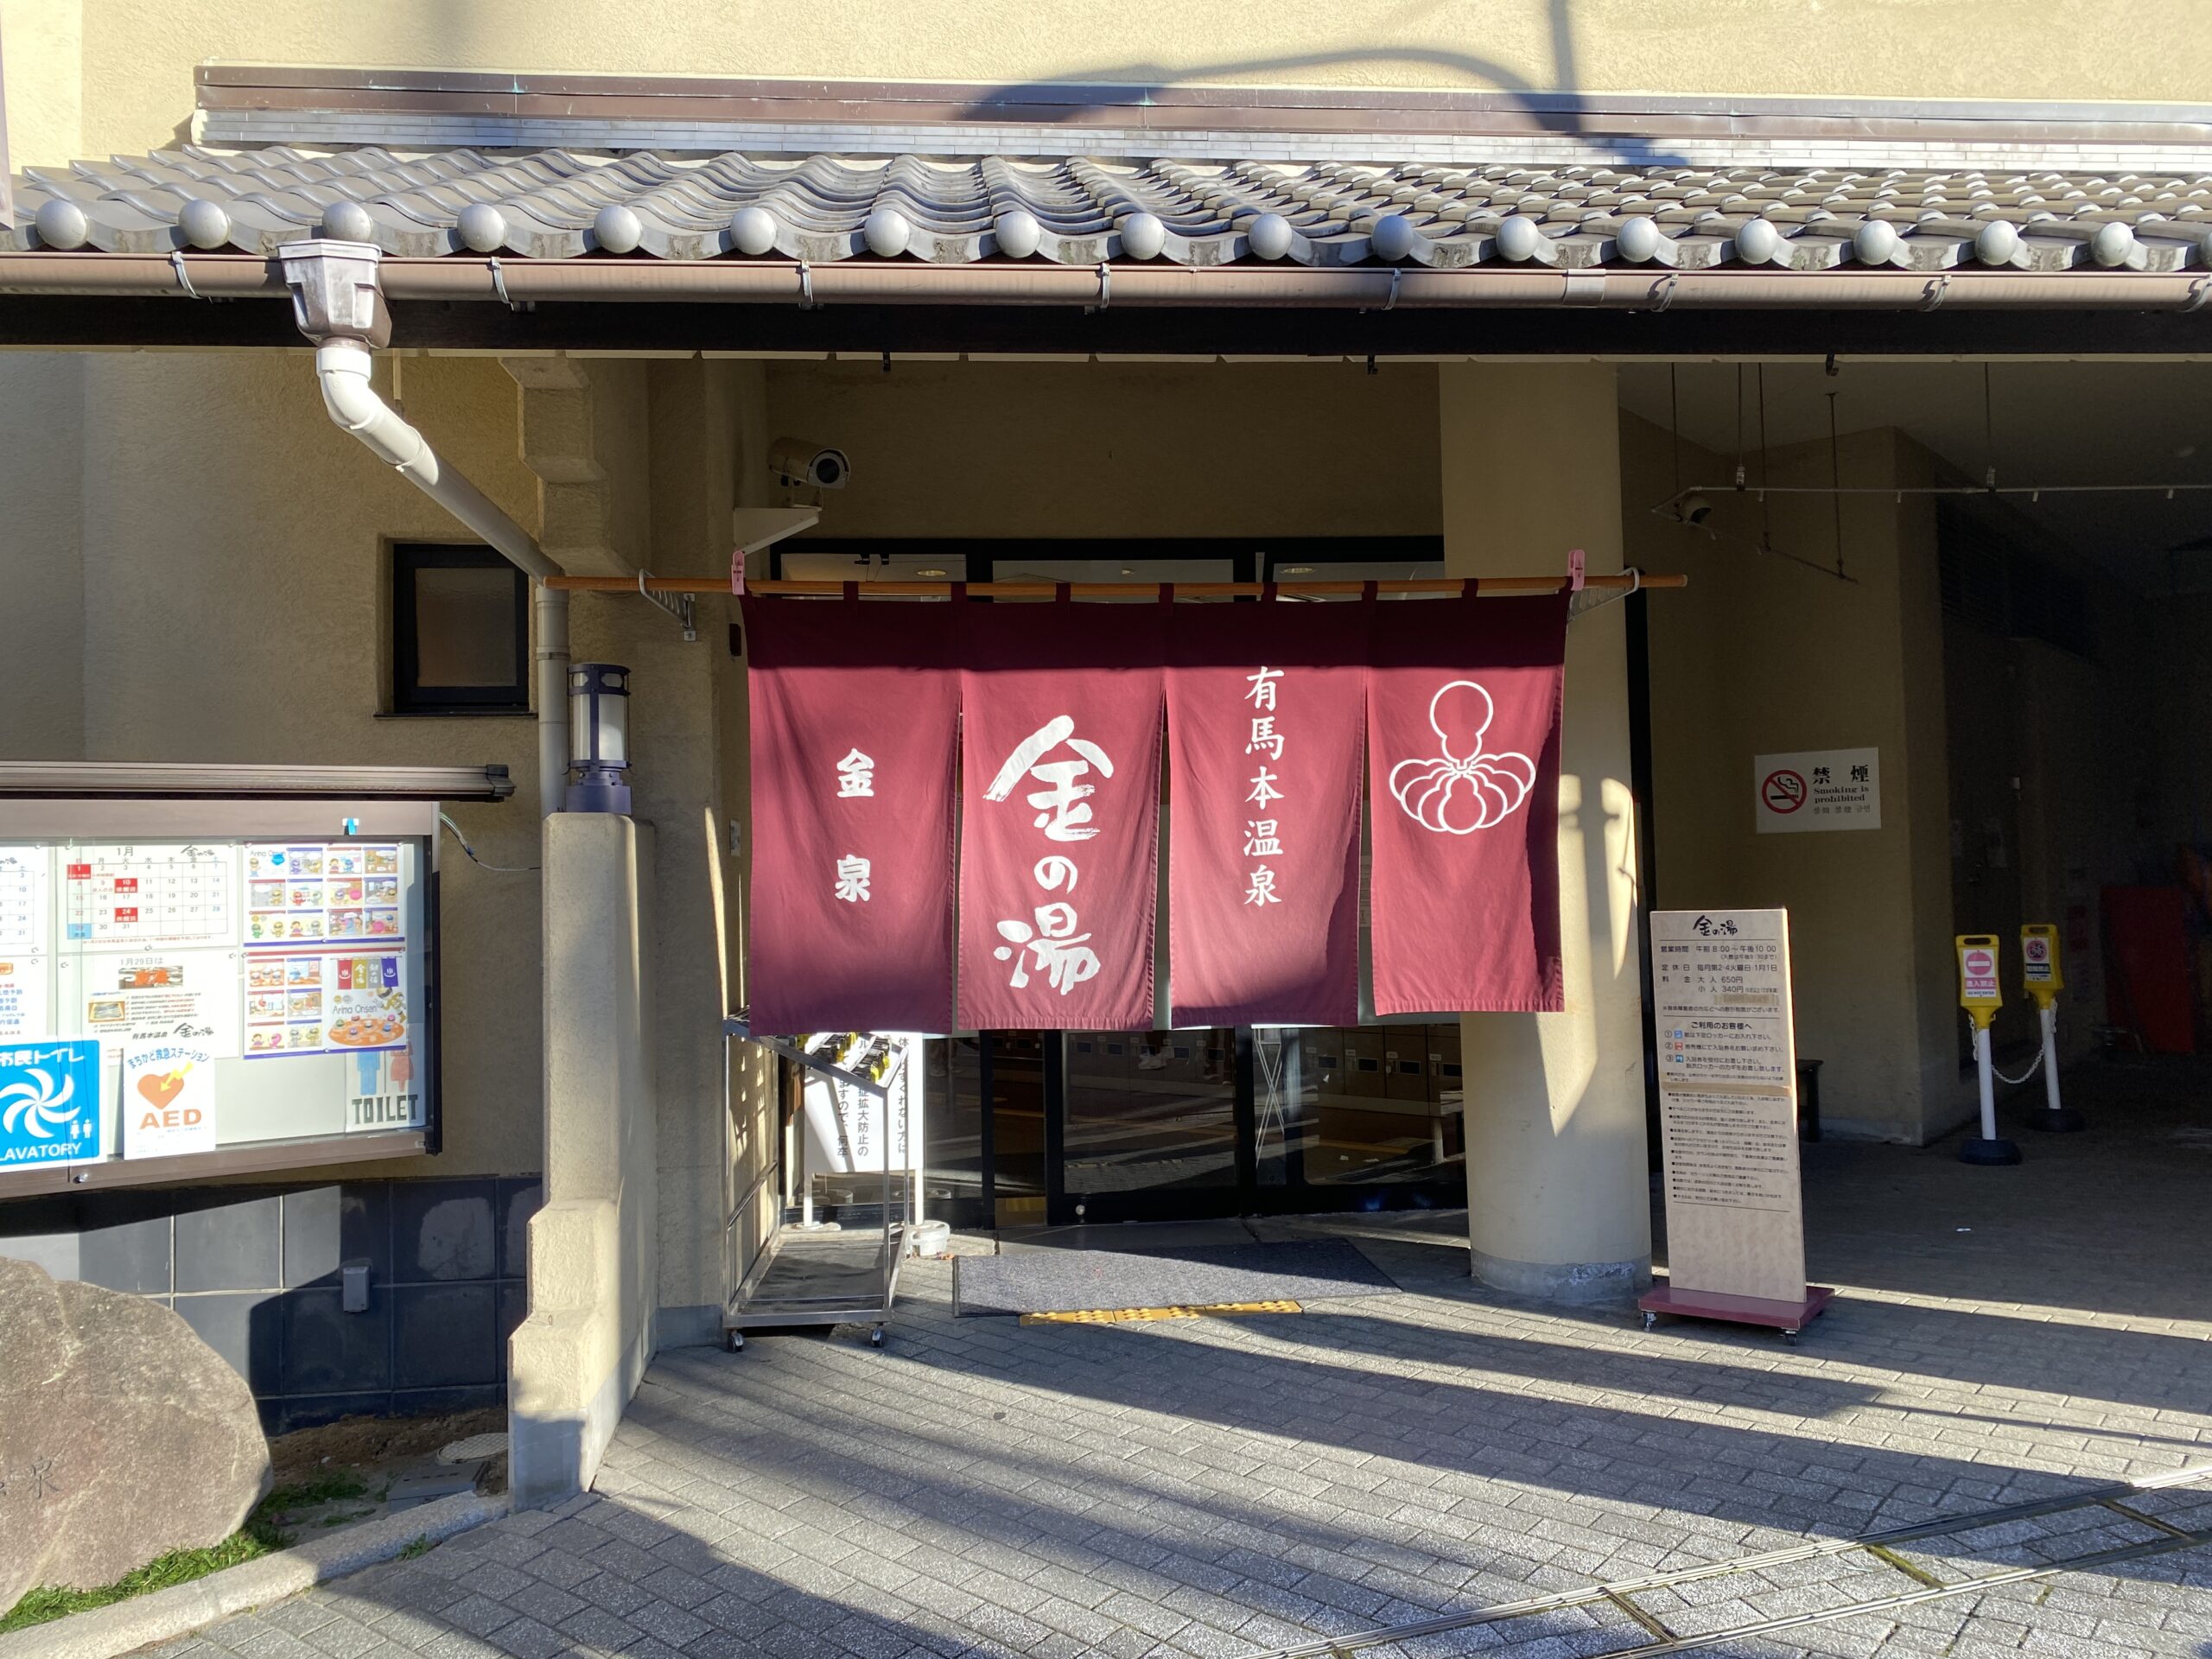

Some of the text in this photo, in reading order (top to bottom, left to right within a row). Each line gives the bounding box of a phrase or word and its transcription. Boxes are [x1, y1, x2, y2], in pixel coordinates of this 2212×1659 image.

[1244, 666, 1285, 906] 有馬本温泉
[1812, 765, 1870, 785] 禁煙
[1815, 794, 1866, 804] prohibited
[835, 747, 874, 902] 金泉
[117, 846, 134, 856] 1月
[983, 714, 1114, 995] 金の湯
[1692, 914, 1739, 936] 金の湯
[127, 1047, 210, 1070] まちかど救急ステーション
[139, 1109, 202, 1130] AED
[352, 1095, 419, 1125] TOILET
